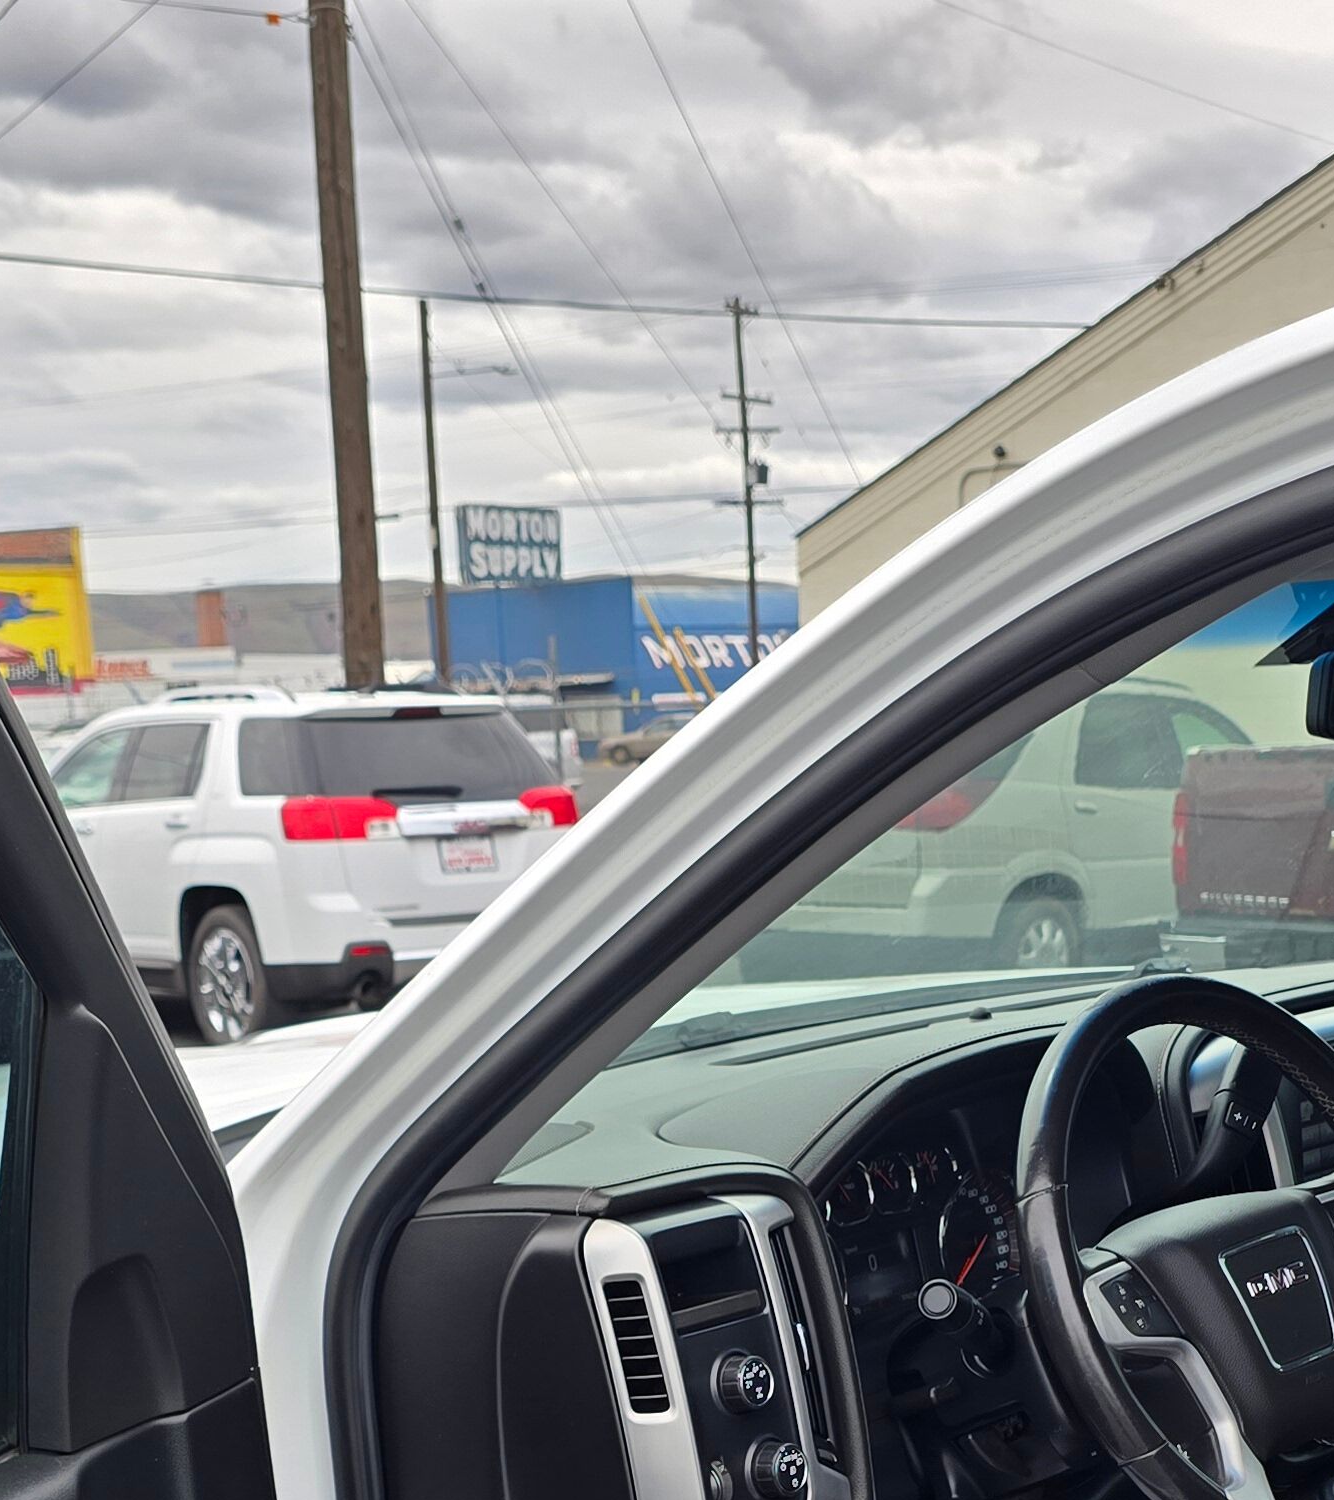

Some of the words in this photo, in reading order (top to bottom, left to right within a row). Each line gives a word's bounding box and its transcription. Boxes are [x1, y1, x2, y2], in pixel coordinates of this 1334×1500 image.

[466, 508, 557, 544] MORTON
[469, 541, 557, 578] SUPPLY
[641, 629, 791, 669] MORTO
